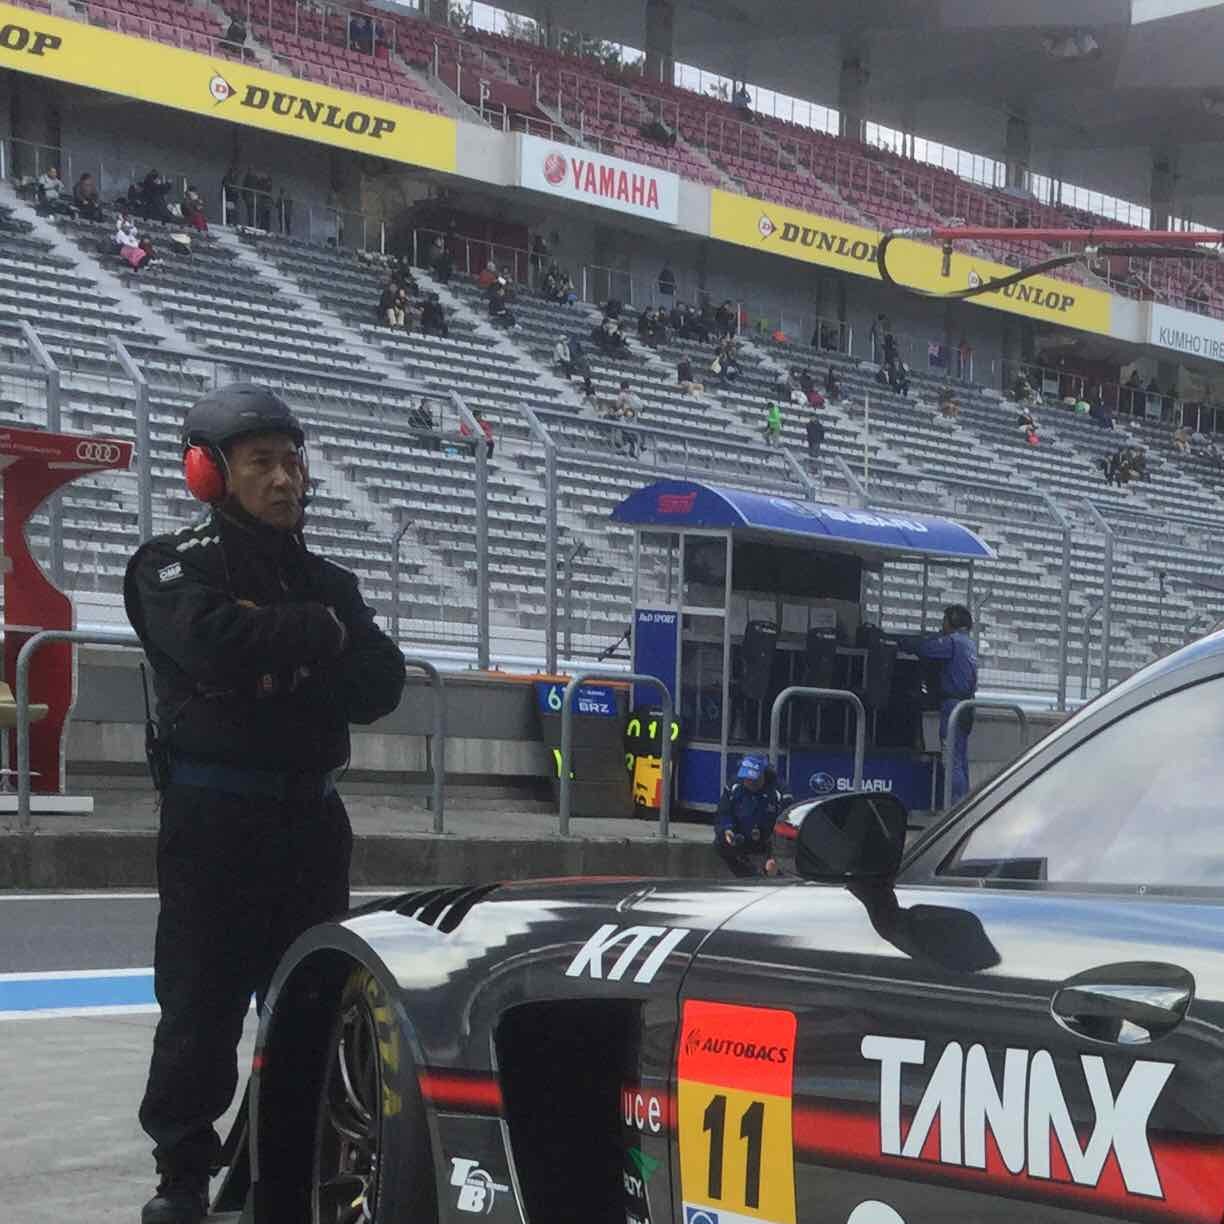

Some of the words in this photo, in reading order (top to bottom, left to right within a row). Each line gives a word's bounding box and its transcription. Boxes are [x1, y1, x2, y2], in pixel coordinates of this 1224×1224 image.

[0, 24, 62, 57] OP
[240, 84, 396, 139] DUNLOP
[571, 157, 660, 211] YAMAHA
[1159, 327, 1200, 353] KUMHO
[701, 1037, 788, 1065] AUTOBACS
[861, 1035, 1176, 1200] TANAX
[702, 1095, 765, 1210] 11
